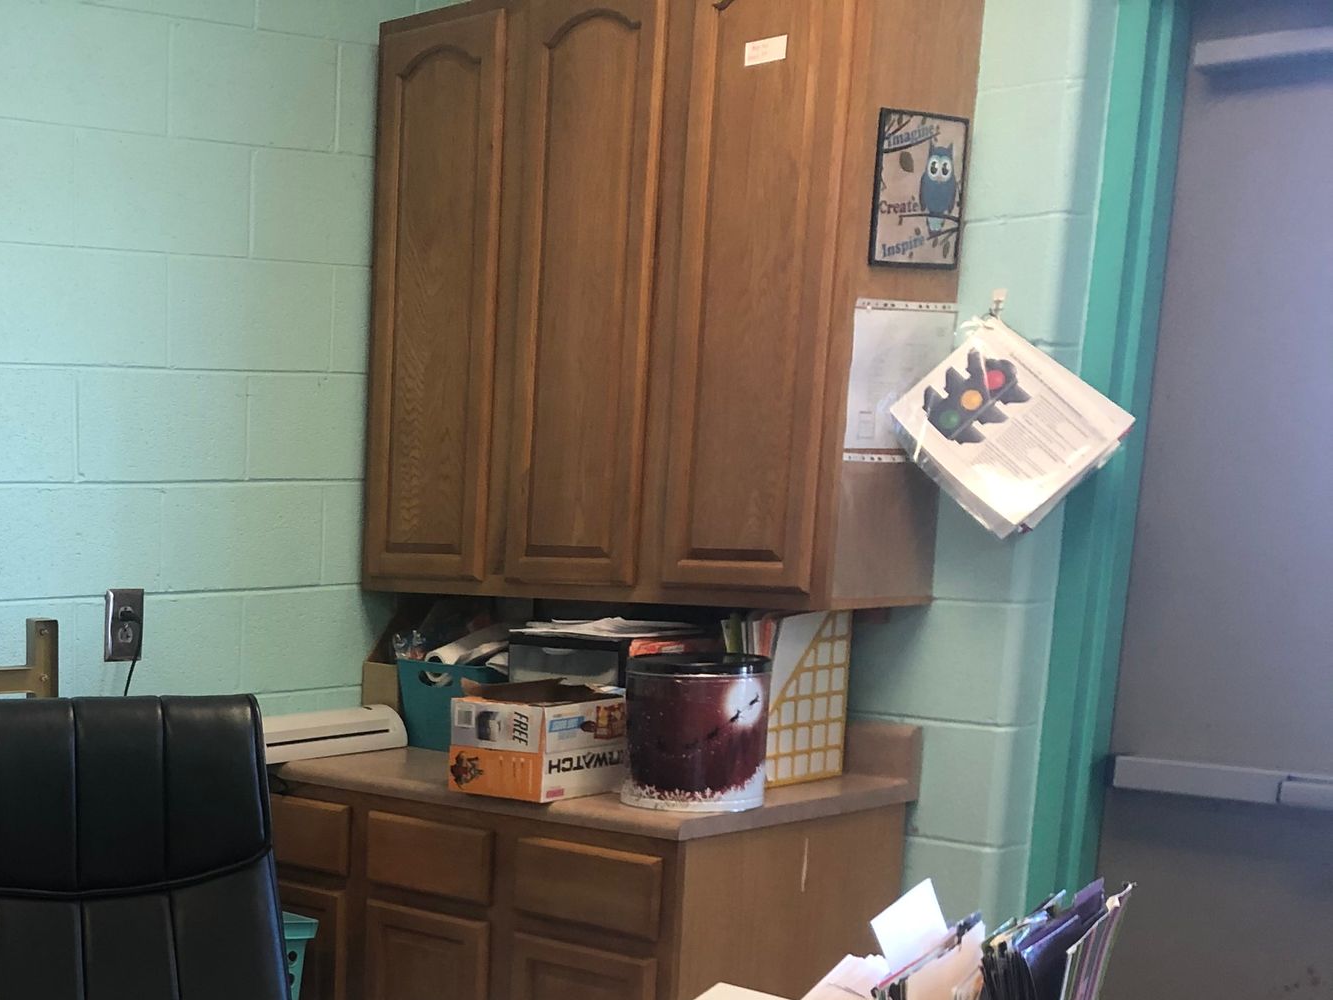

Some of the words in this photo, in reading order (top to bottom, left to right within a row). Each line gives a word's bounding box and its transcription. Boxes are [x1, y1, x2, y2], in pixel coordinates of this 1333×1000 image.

[887, 124, 934, 148] Imagine
[879, 200, 919, 215] Create
[881, 235, 925, 257] Inspire
[512, 711, 529, 747] FREE
